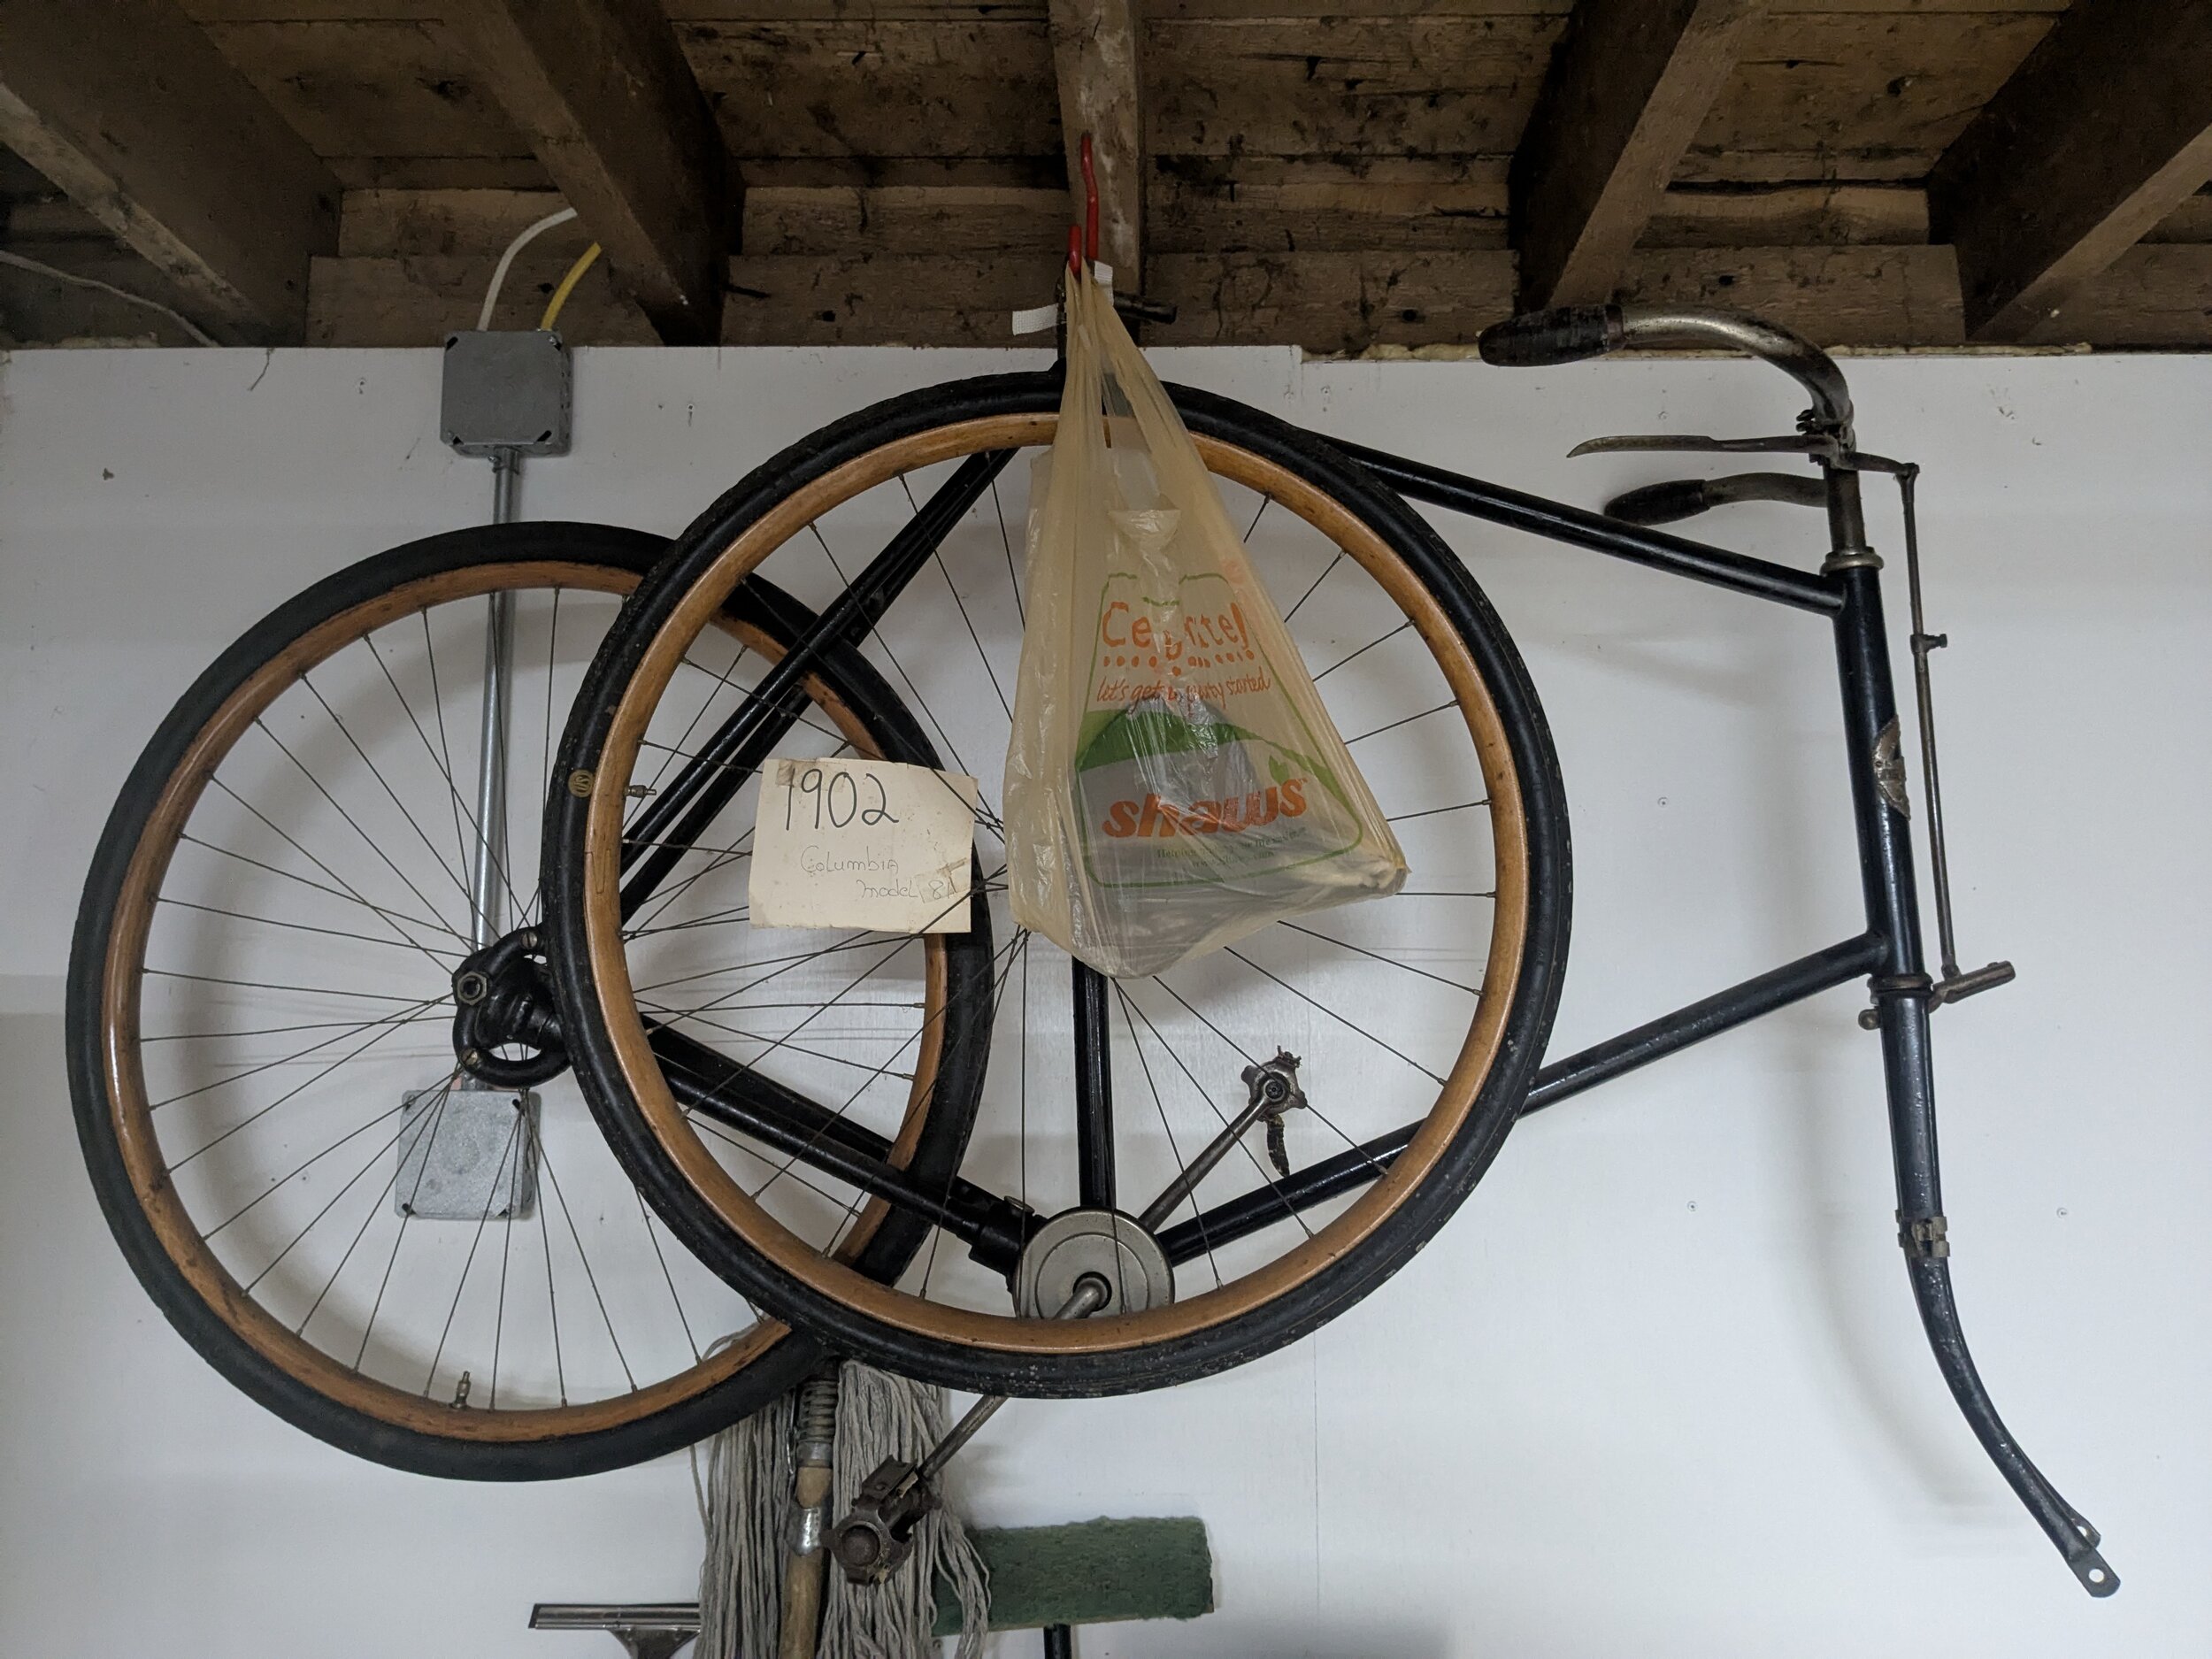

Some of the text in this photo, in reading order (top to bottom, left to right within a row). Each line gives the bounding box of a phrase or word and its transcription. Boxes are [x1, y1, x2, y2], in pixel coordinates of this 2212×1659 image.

[1097, 676, 1130, 703] let's
[1225, 665, 1271, 695] started
[786, 767, 899, 831] 1902
